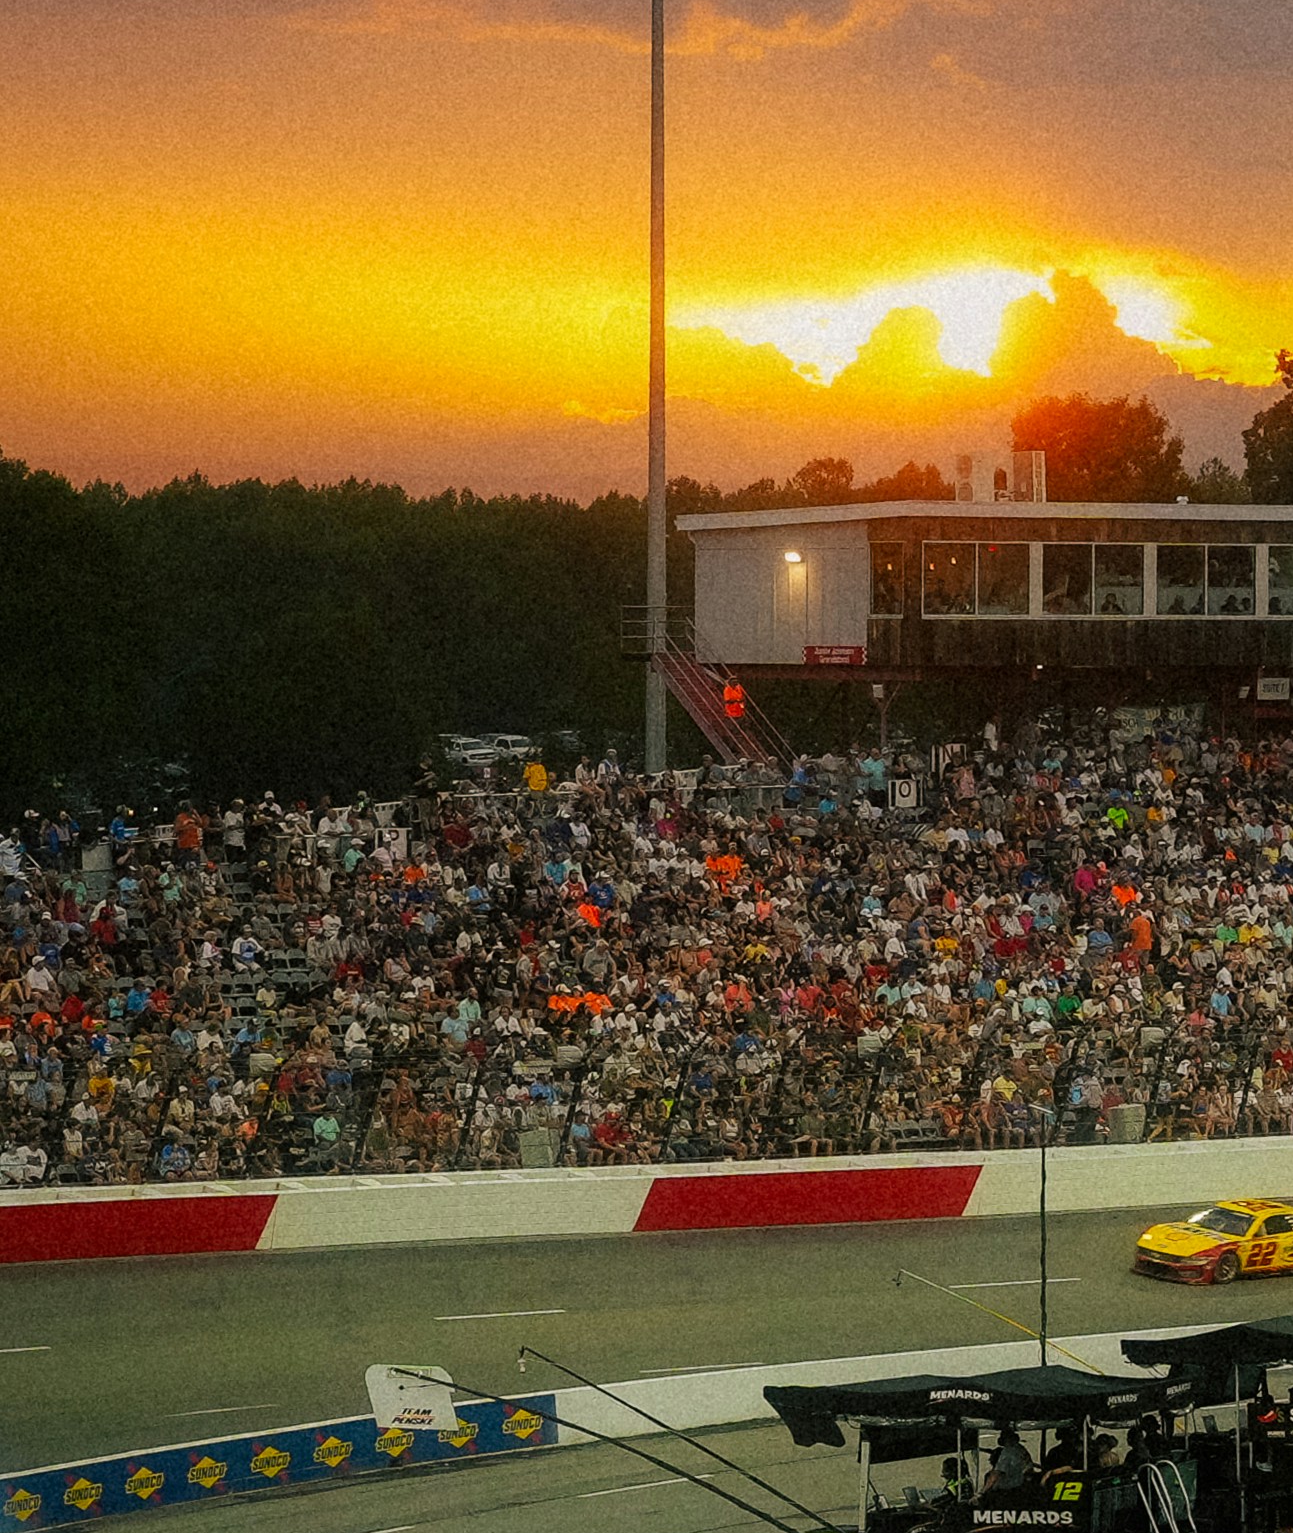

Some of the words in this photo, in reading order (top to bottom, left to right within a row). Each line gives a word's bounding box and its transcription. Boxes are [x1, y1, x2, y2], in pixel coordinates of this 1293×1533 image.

[1246, 1241, 1278, 1267] 22
[930, 1389, 990, 1402] MENARDS
[401, 1407, 432, 1416] TEAM
[391, 1417, 433, 1426] PENSKE
[504, 1415, 542, 1434] SUNOCO
[314, 1442, 351, 1461] SUNOCO
[376, 1432, 413, 1452] SUNOCO
[252, 1452, 289, 1472] SUNOCO
[189, 1462, 227, 1482] SUNOCO
[127, 1473, 163, 1493] SUNOCO
[1052, 1481, 1083, 1501] 12
[65, 1484, 101, 1504] SUNOCO
[4, 1496, 40, 1515] SUNOCO
[973, 1509, 1073, 1525] MENARDS
